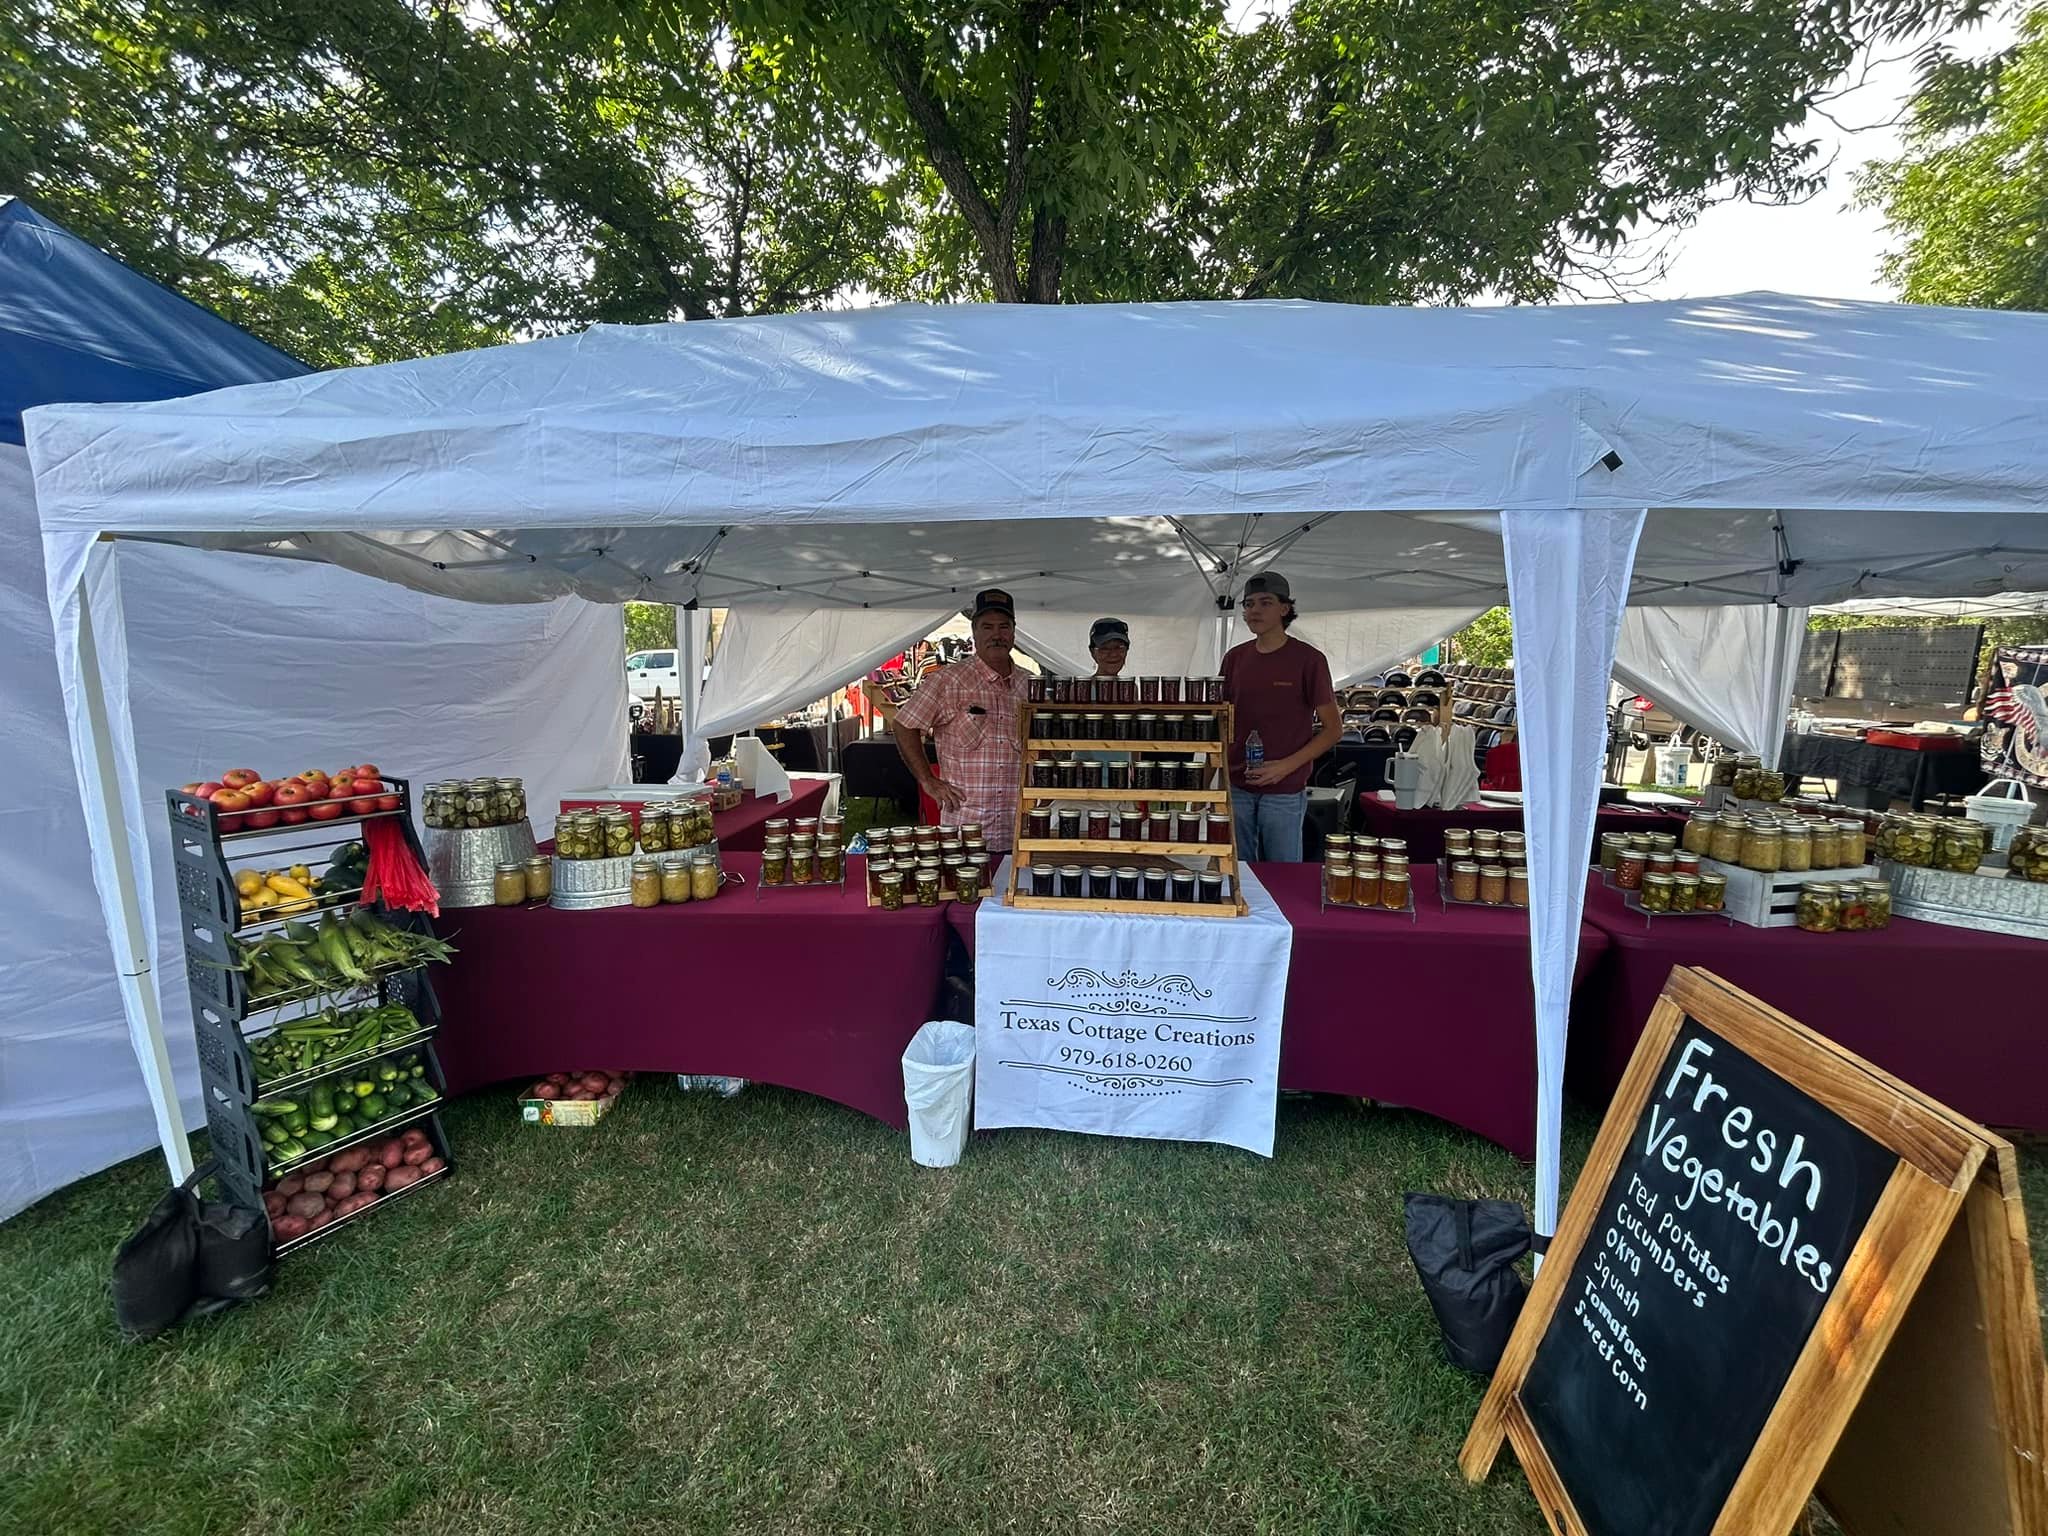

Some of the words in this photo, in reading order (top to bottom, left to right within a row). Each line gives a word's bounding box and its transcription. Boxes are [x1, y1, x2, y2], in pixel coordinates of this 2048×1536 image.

[1000, 1011, 1060, 1033] Texas
[1067, 1016, 1147, 1044] Cottage
[1154, 1023, 1256, 1048] Creations
[1060, 1047, 1192, 1072] 979-618-0260
[1665, 1038, 1821, 1211] Fresh
[1628, 1172, 1659, 1218] red
[1645, 1104, 1832, 1292] Vegetables
[1593, 1251, 1640, 1317] Squash
[1617, 1203, 1707, 1308] Cucumbers
[1585, 1275, 1648, 1372] Tomatoes
